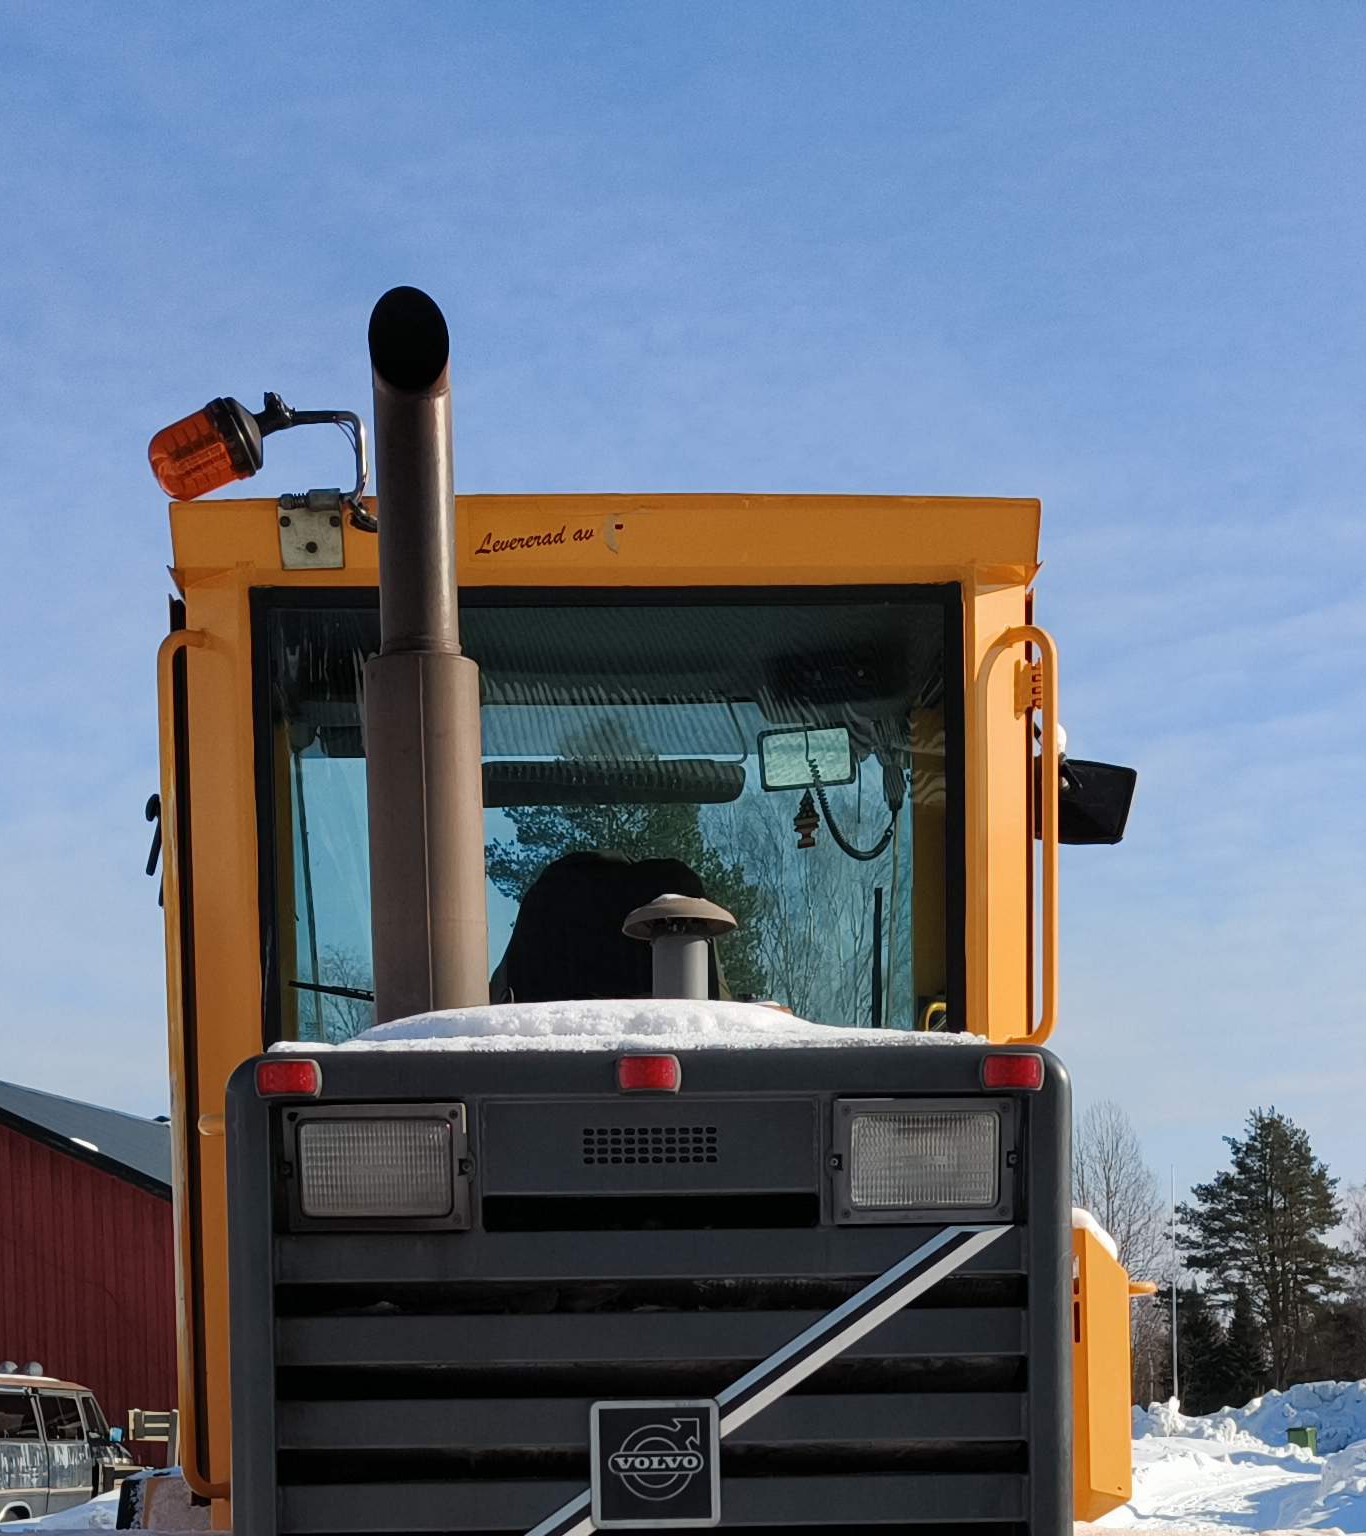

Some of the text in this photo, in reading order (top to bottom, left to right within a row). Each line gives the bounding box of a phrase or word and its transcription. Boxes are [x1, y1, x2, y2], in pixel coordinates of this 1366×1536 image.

[475, 525, 594, 555] Levererad av
[614, 1455, 698, 1470] VOLVO
